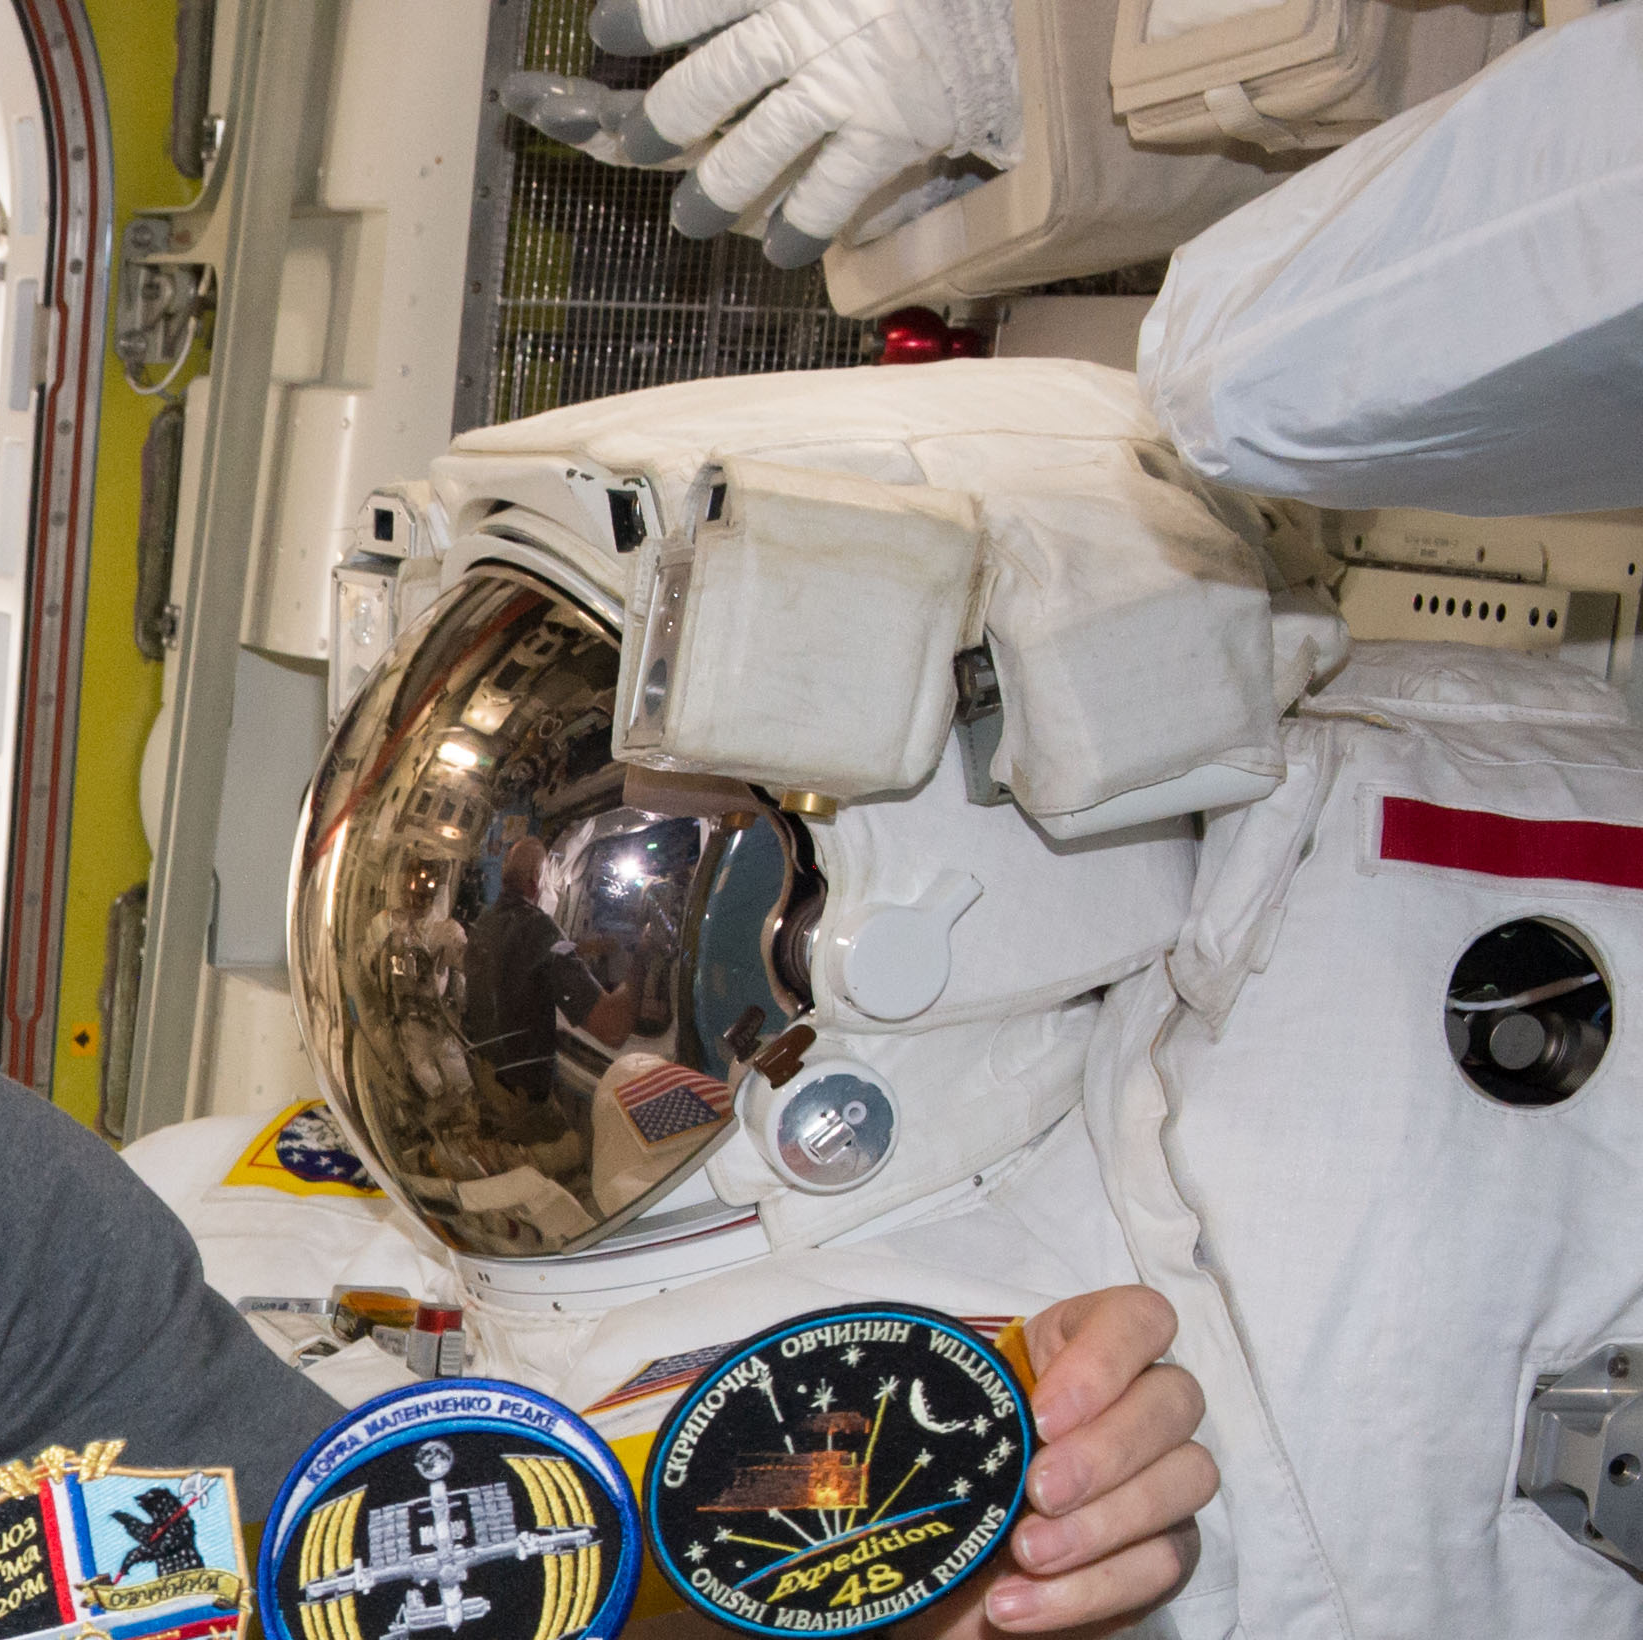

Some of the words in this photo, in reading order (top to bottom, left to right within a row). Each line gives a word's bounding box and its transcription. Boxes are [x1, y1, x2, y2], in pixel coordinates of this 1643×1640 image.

[780, 1321, 913, 1360] ОВЧИНИН
[928, 1329, 1016, 1420] WILLIAMS
[663, 1355, 770, 1490] СКРИПОЧКА
[767, 1520, 955, 1603] Expedition
[931, 1504, 1008, 1587] RUBINS
[690, 1567, 769, 1625] ONISHI
[774, 1583, 930, 1632] ИВАНИШИН
[828, 1564, 905, 1608] 48
